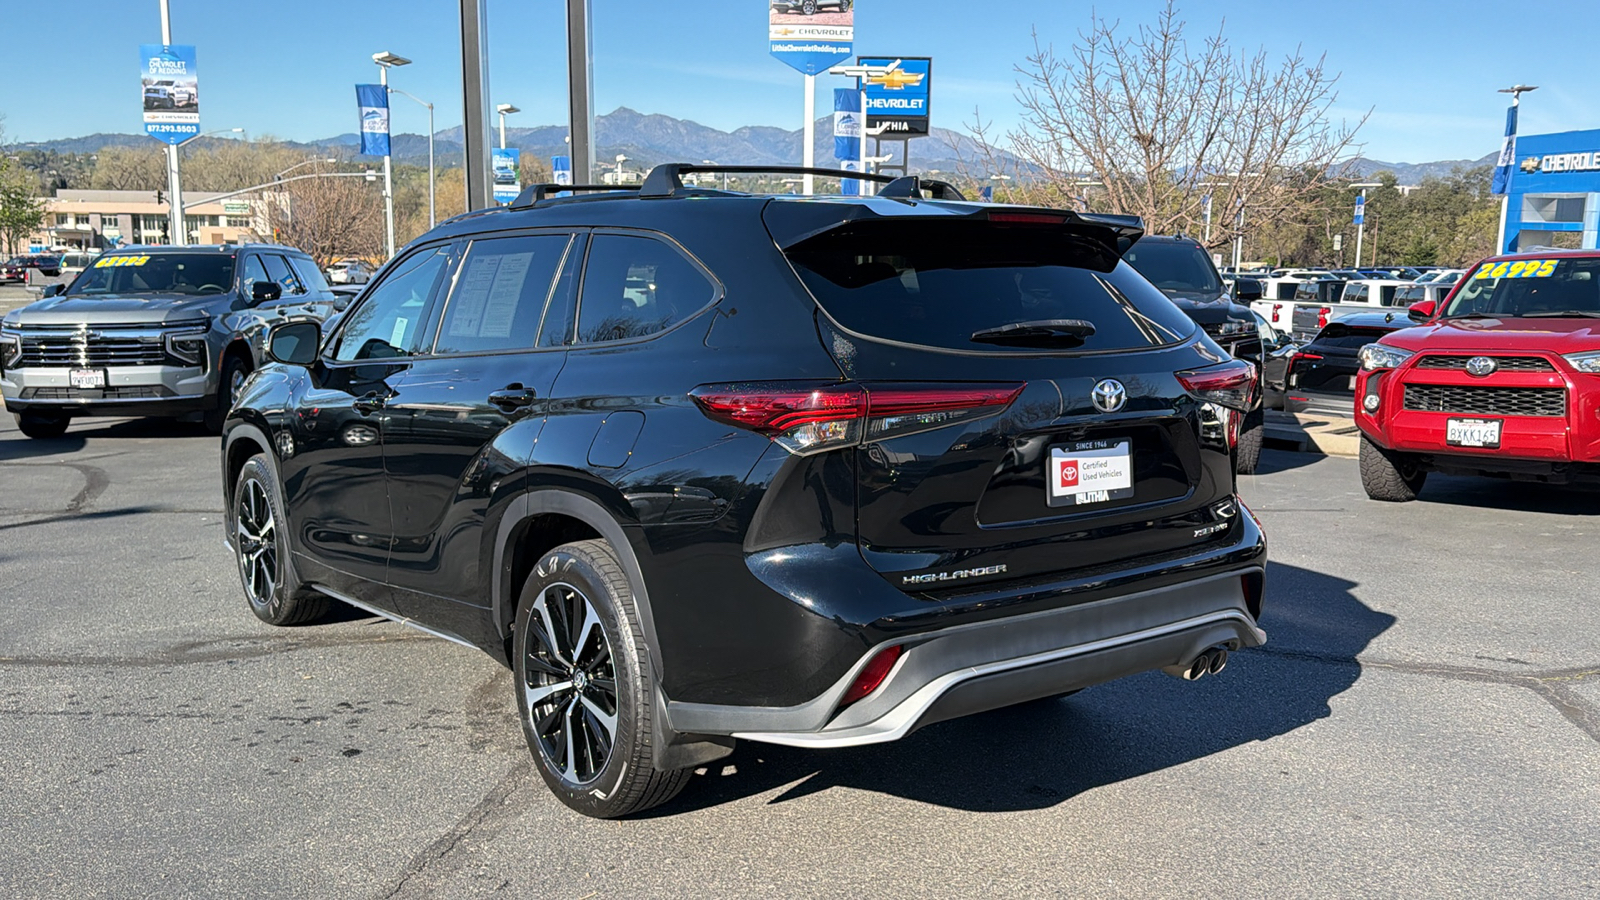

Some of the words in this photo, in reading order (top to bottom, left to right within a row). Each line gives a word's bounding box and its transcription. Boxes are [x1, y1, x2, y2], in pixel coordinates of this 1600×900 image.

[798, 28, 850, 36] CHEVROLET
[771, 44, 851, 54] LithiaChevroletRedding.com
[147, 124, 197, 133] 877.293.5503
[1541, 152, 1600, 172] CHEVROLE
[1474, 259, 1559, 279] 26995
[1450, 428, 1496, 442] 8XKK165
[1075, 442, 1093, 450] SINCE
[1094, 441, 1107, 449] 1946
[1082, 459, 1108, 471] Certified
[1082, 471, 1098, 481] Used
[1098, 469, 1123, 479] Vehicles
[1085, 489, 1110, 503] LITHIA
[902, 563, 1008, 585] HIGHLANDER
